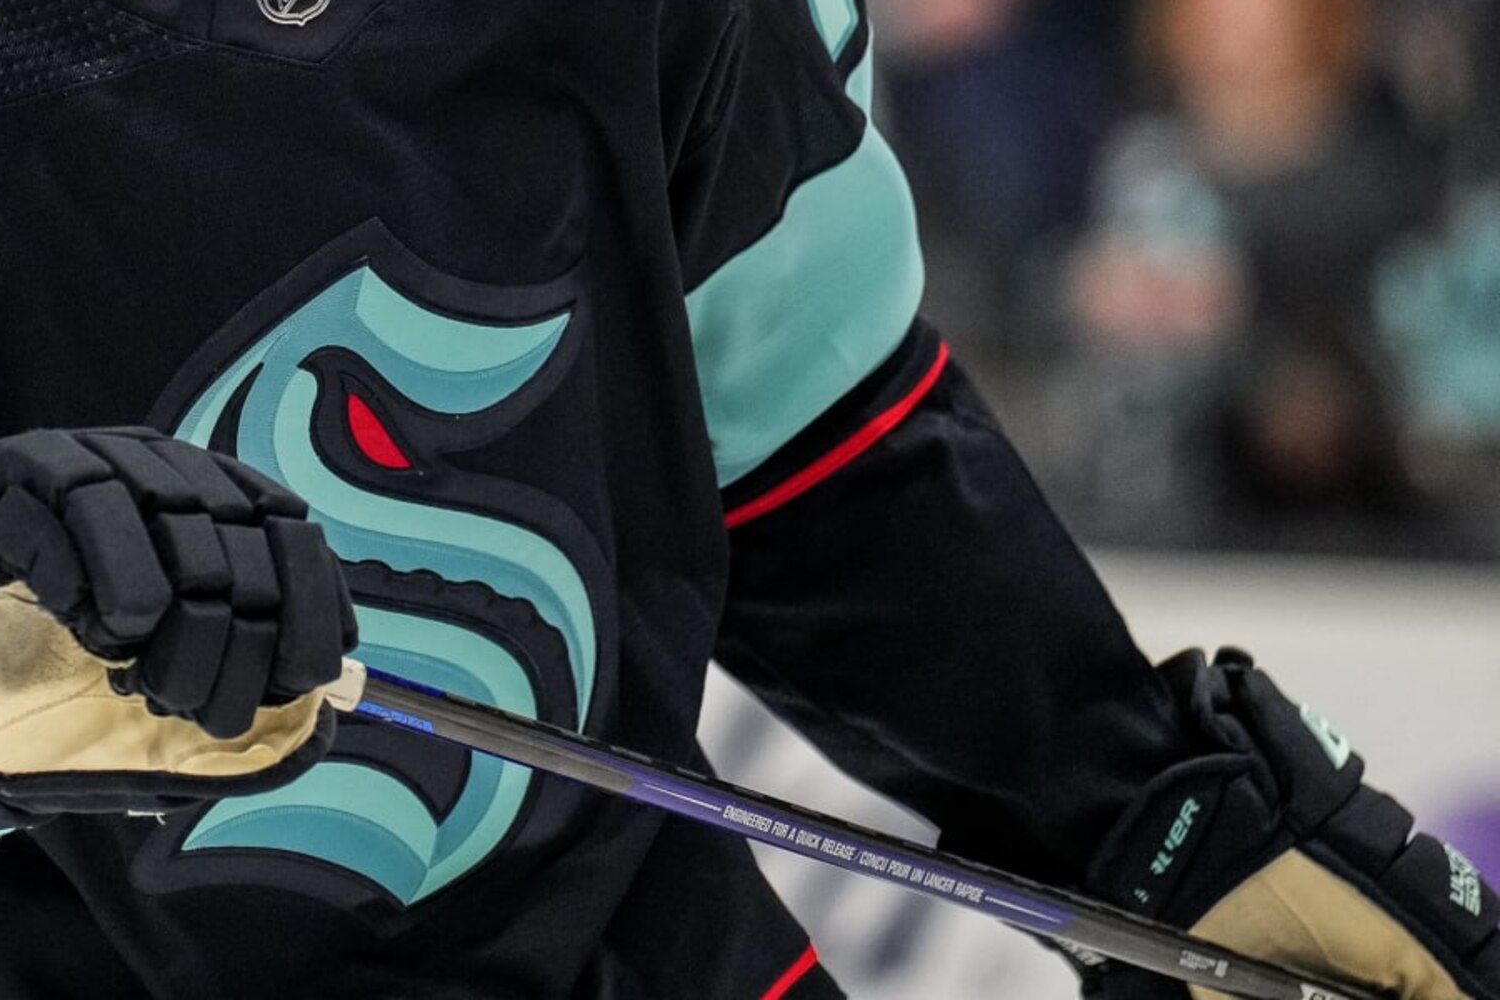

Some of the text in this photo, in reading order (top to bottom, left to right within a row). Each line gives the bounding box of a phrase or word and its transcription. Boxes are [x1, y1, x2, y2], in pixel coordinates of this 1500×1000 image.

[723, 804, 773, 833] ENGINEERED
[771, 820, 789, 839] FOR
[787, 826, 798, 841] A
[795, 829, 822, 849] QUICK
[819, 838, 857, 861] RELEASE
[887, 860, 912, 880] POUR
[909, 867, 925, 883] UN
[922, 871, 956, 894] LANCER
[953, 881, 984, 903] RAPIDE
